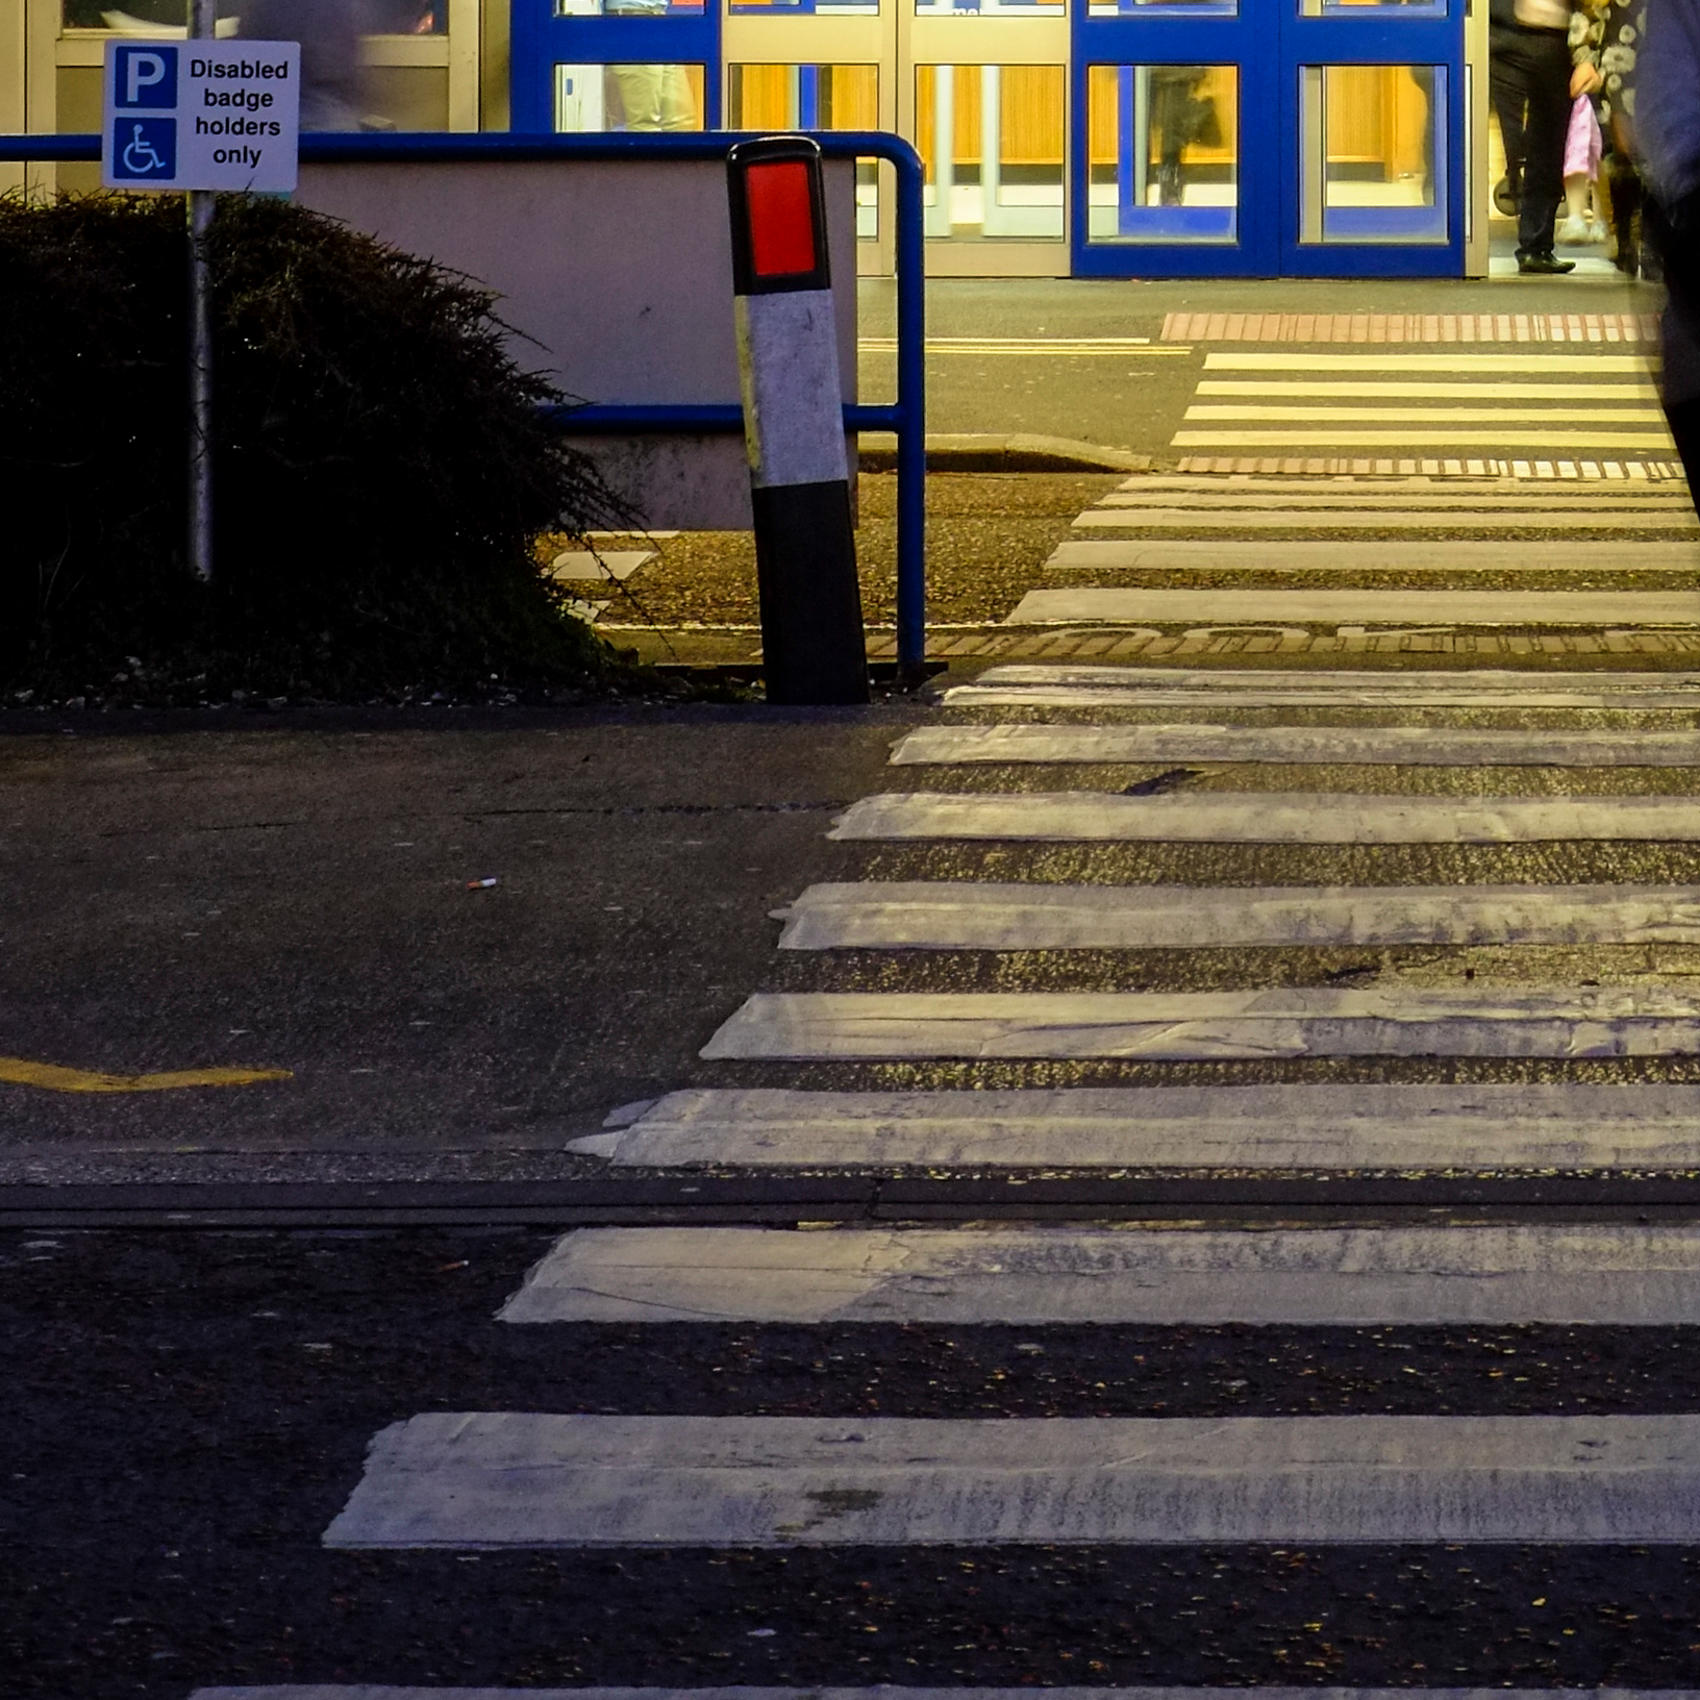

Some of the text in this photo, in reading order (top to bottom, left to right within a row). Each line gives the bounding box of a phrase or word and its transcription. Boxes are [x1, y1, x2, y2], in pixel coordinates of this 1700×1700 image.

[127, 52, 166, 102] P
[190, 59, 289, 79] Disabled
[204, 87, 274, 112] badge
[195, 117, 281, 136] holders
[213, 145, 262, 169] only
